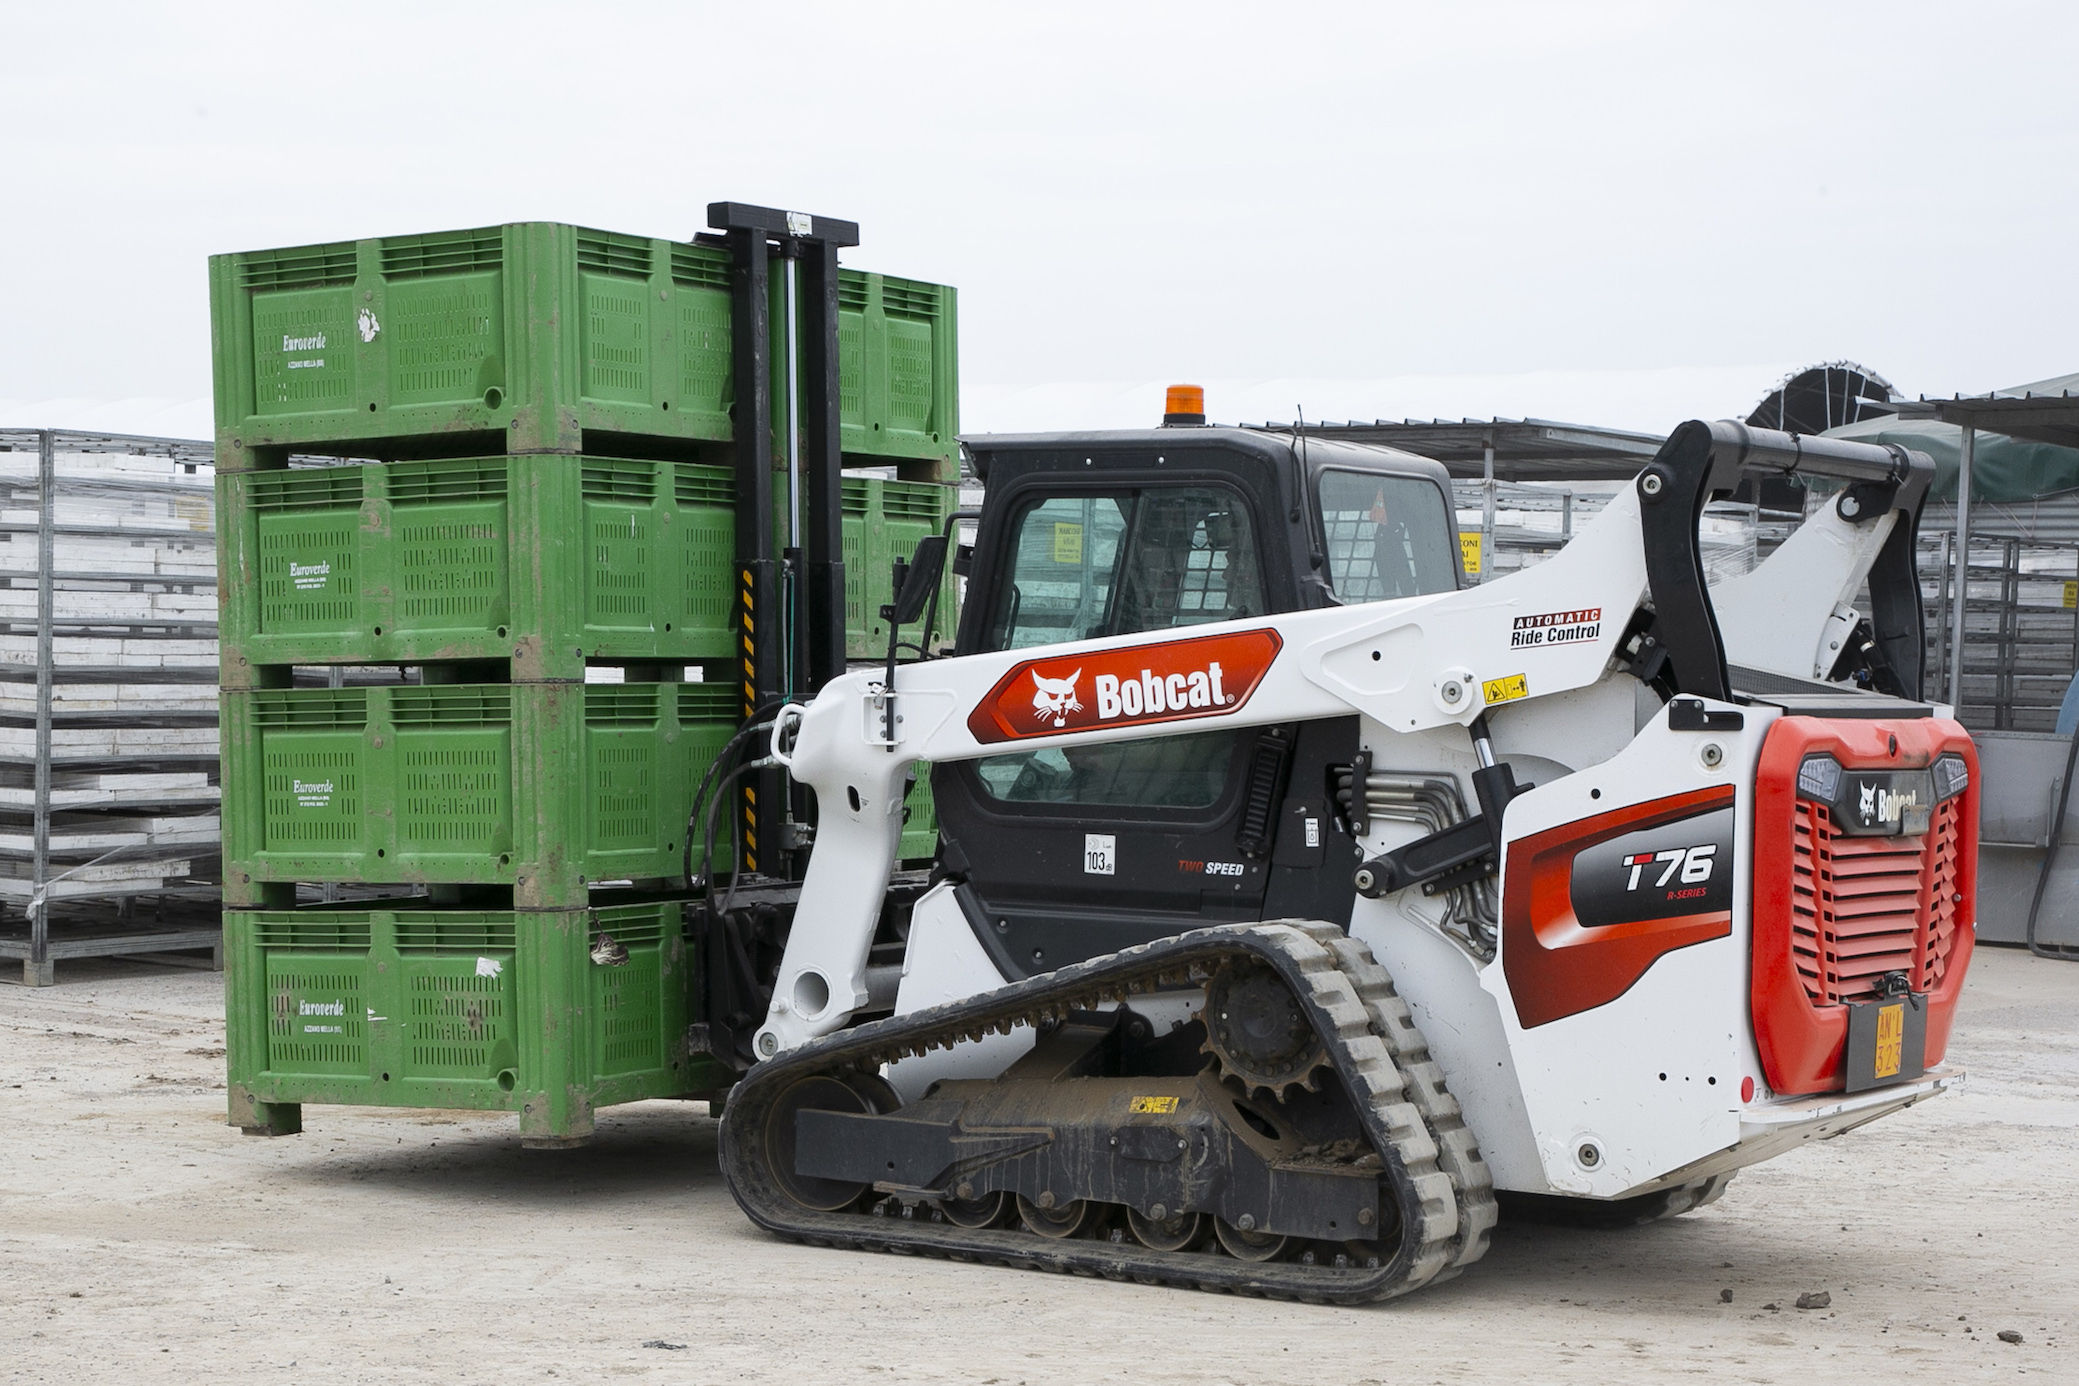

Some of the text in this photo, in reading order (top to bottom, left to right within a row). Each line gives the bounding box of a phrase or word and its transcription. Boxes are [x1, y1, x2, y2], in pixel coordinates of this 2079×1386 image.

[283, 331, 326, 352] Euroverde
[289, 560, 330, 577] Euroverde
[1515, 609, 1599, 629] AUTOMATIC
[1511, 622, 1600, 646] Ride Control
[1095, 661, 1226, 720] Bobcat
[293, 778, 334, 793] Euroverde
[1087, 851, 1105, 871] 103
[1178, 860, 1245, 876] TWO SPEED
[1623, 844, 1717, 891] T76
[1666, 887, 1707, 900] R-SERIES
[299, 998, 344, 1016] Euroverde
